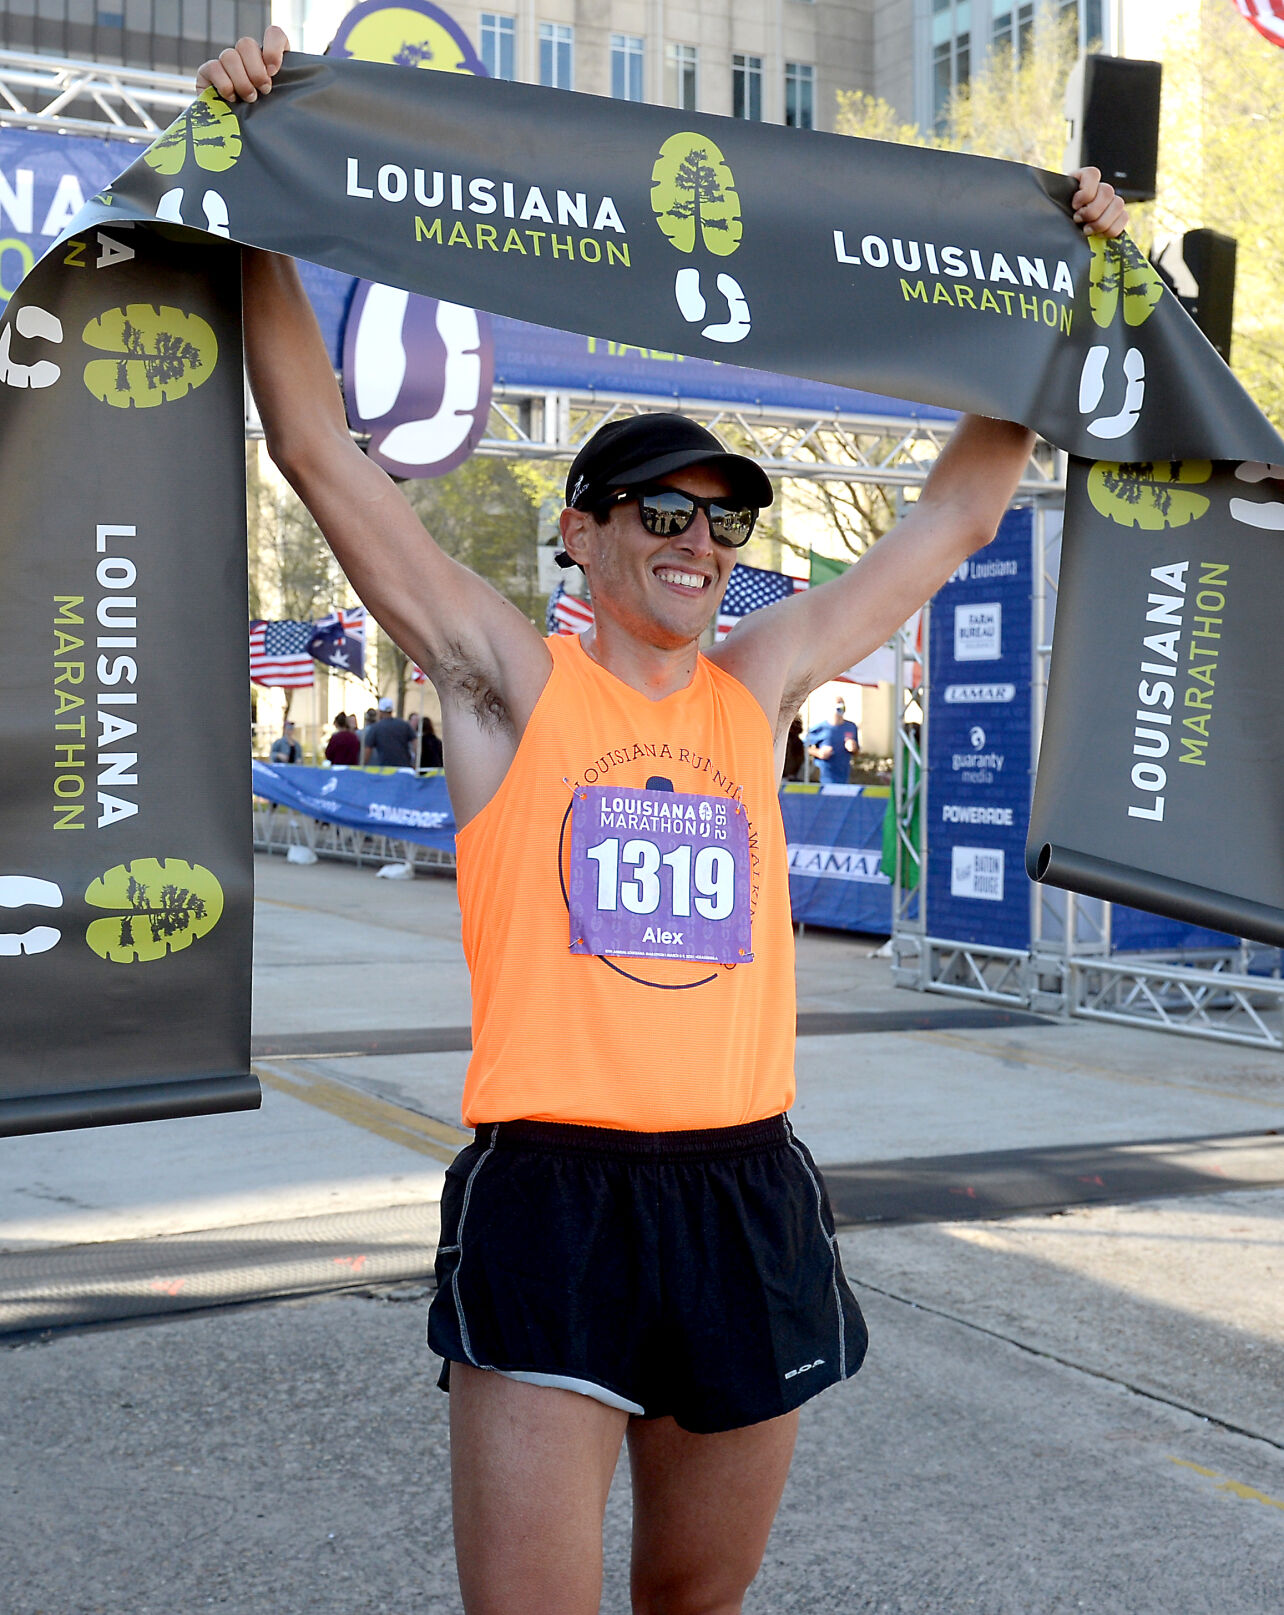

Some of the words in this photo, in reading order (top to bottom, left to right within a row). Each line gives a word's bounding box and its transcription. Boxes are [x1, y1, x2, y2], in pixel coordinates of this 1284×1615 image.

[346, 158, 626, 234] LOUISIANA
[414, 215, 631, 268] MARATHON
[833, 230, 1075, 299] LOUISIANA
[900, 278, 1074, 337] MARATHON
[970, 560, 1018, 579] Louisiana
[95, 524, 138, 829] LOUISIANA
[1128, 560, 1189, 822] LOUISIANA
[1178, 562, 1230, 767] MARATHON
[53, 595, 85, 831] MARATHON
[951, 687, 1007, 700] LAMAR
[574, 743, 673, 788] OUISIANA
[600, 812, 697, 836] MARATHON
[601, 796, 697, 821] LOUISIANA
[714, 803, 727, 841] 26.2
[942, 805, 1014, 826] POWERADE
[586, 837, 736, 922] 1319
[642, 927, 684, 946] Alex
